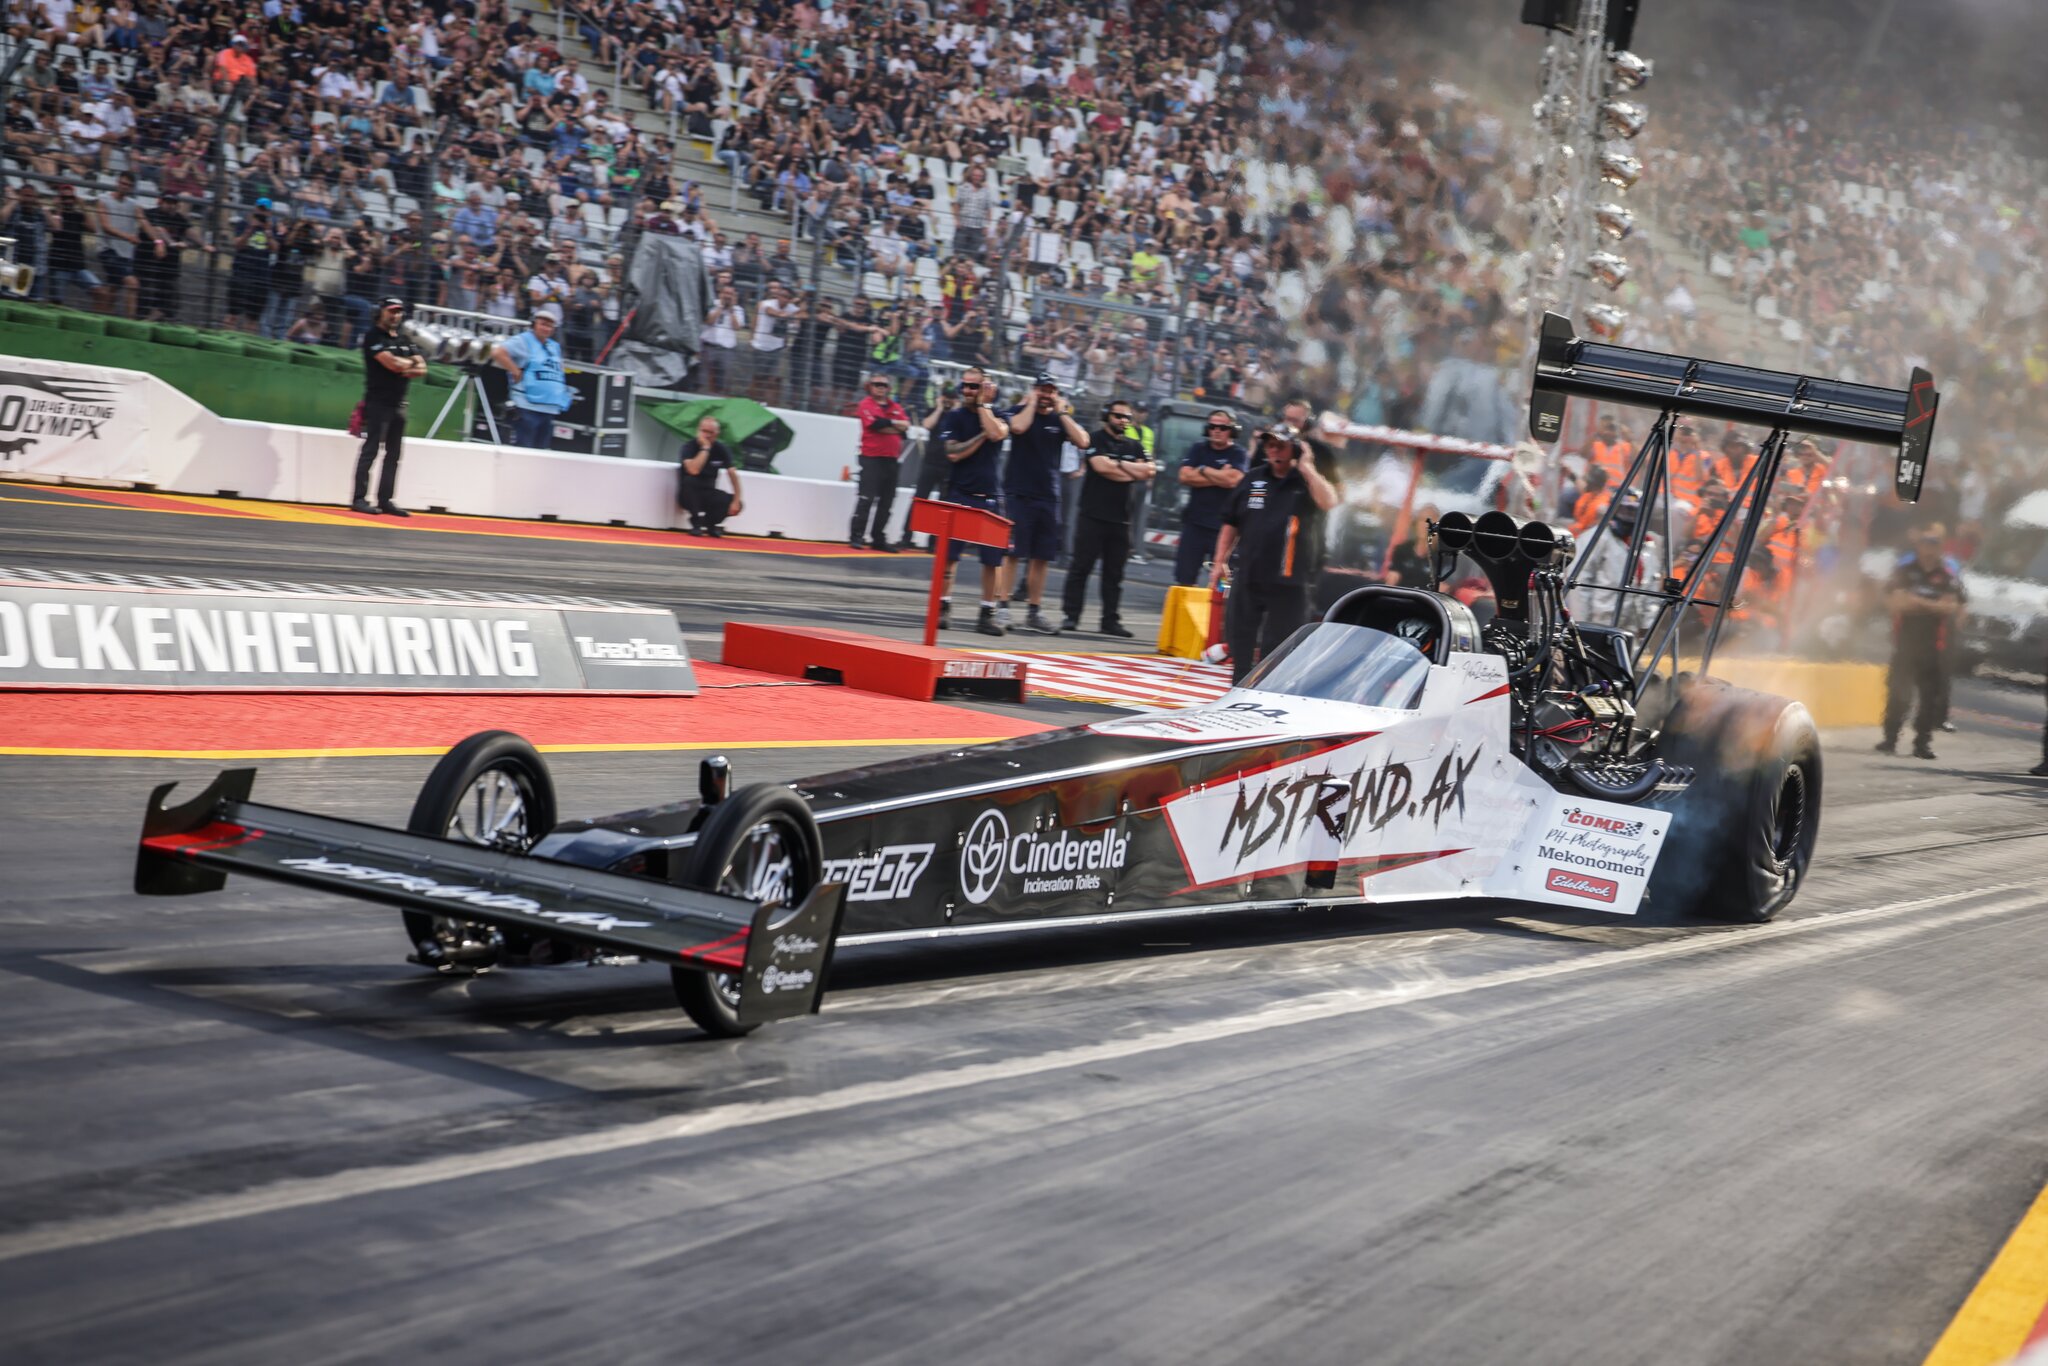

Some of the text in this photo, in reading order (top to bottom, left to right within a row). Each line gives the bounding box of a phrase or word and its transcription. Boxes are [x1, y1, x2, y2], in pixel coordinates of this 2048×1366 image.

[943, 661, 1018, 678] START LINE
[1568, 811, 1626, 832] COMP
[1009, 828, 1126, 874] Cinderella
[1538, 845, 1645, 877] Mekonomen
[1023, 874, 1100, 894] Incineration Toilets
[1551, 875, 1611, 897] Edelbrock
